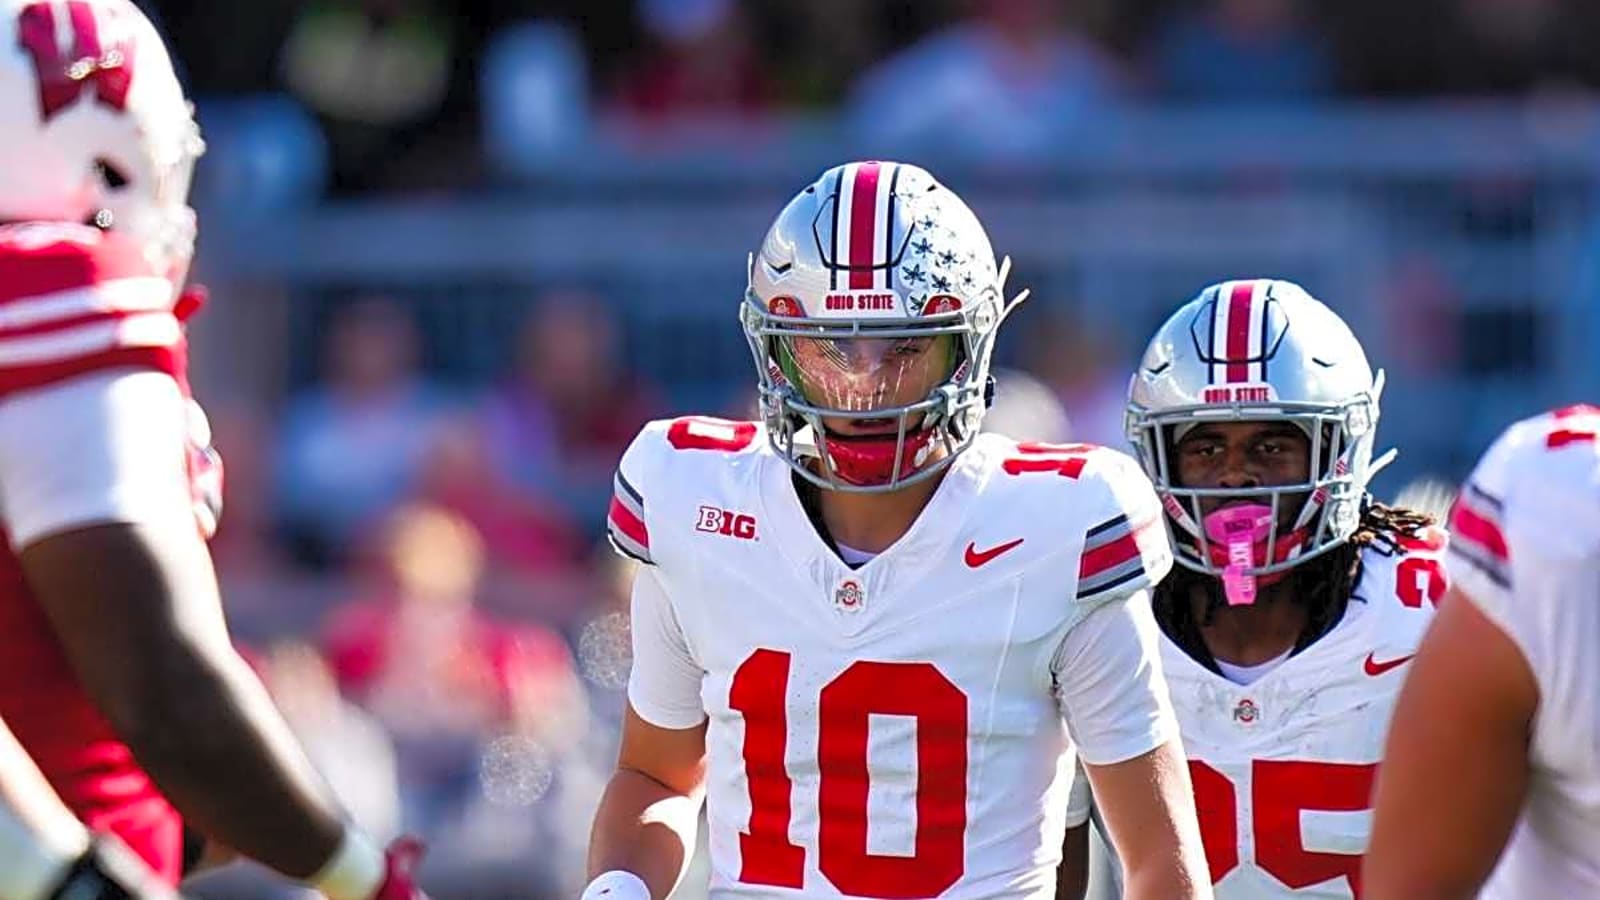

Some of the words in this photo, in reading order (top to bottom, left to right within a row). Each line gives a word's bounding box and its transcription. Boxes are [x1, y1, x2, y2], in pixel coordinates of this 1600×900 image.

[826, 295, 854, 310] OHIO
[858, 294, 893, 310] STATE
[1205, 388, 1231, 403] OHIO
[1236, 387, 1269, 402] STATE
[729, 647, 968, 898] 10
